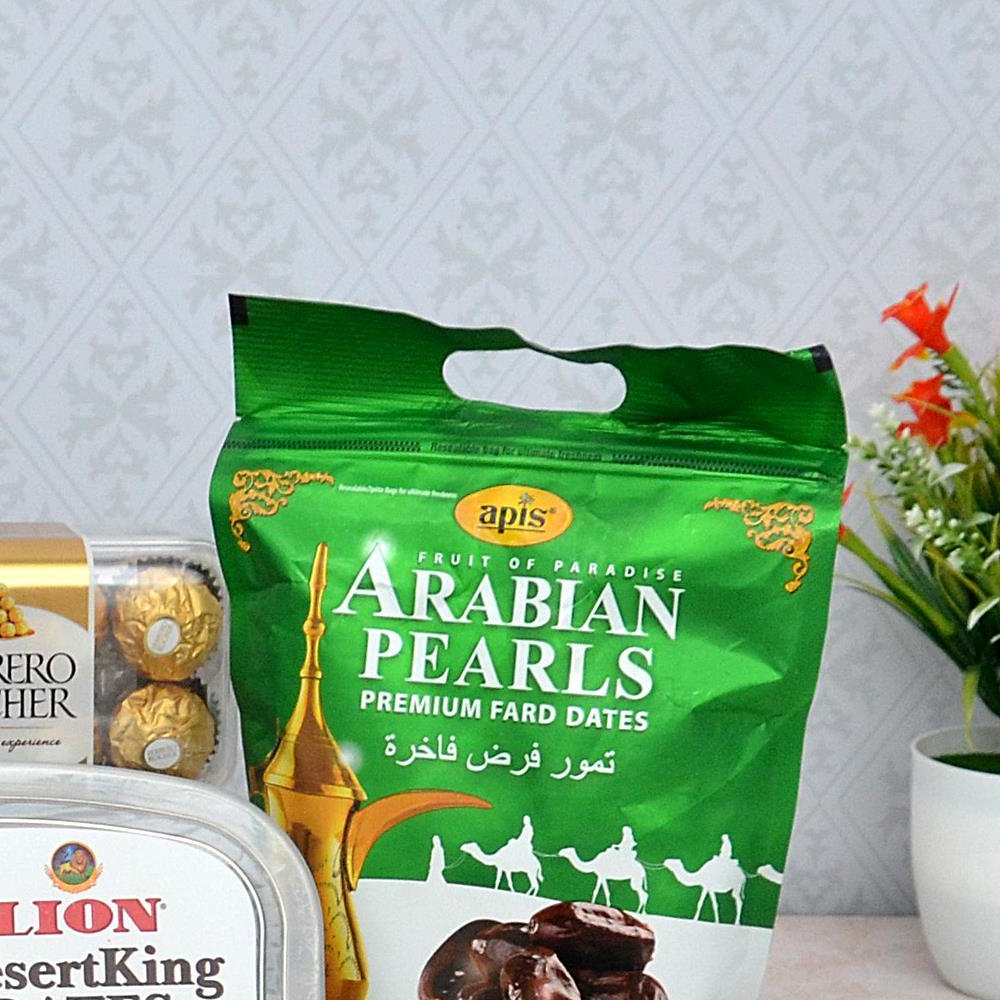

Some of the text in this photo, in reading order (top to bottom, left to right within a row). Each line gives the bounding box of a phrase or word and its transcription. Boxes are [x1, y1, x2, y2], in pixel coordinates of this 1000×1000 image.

[478, 500, 548, 535] apis
[418, 551, 683, 582] FRUIT OF PARADISE
[332, 541, 686, 640] ARABIAN
[358, 627, 654, 701] PEARLS
[360, 689, 649, 731] PREMIUM FARD DATES
[0, 737, 62, 752] experience
[384, 734, 616, 780] تمور فرض فاخرة
